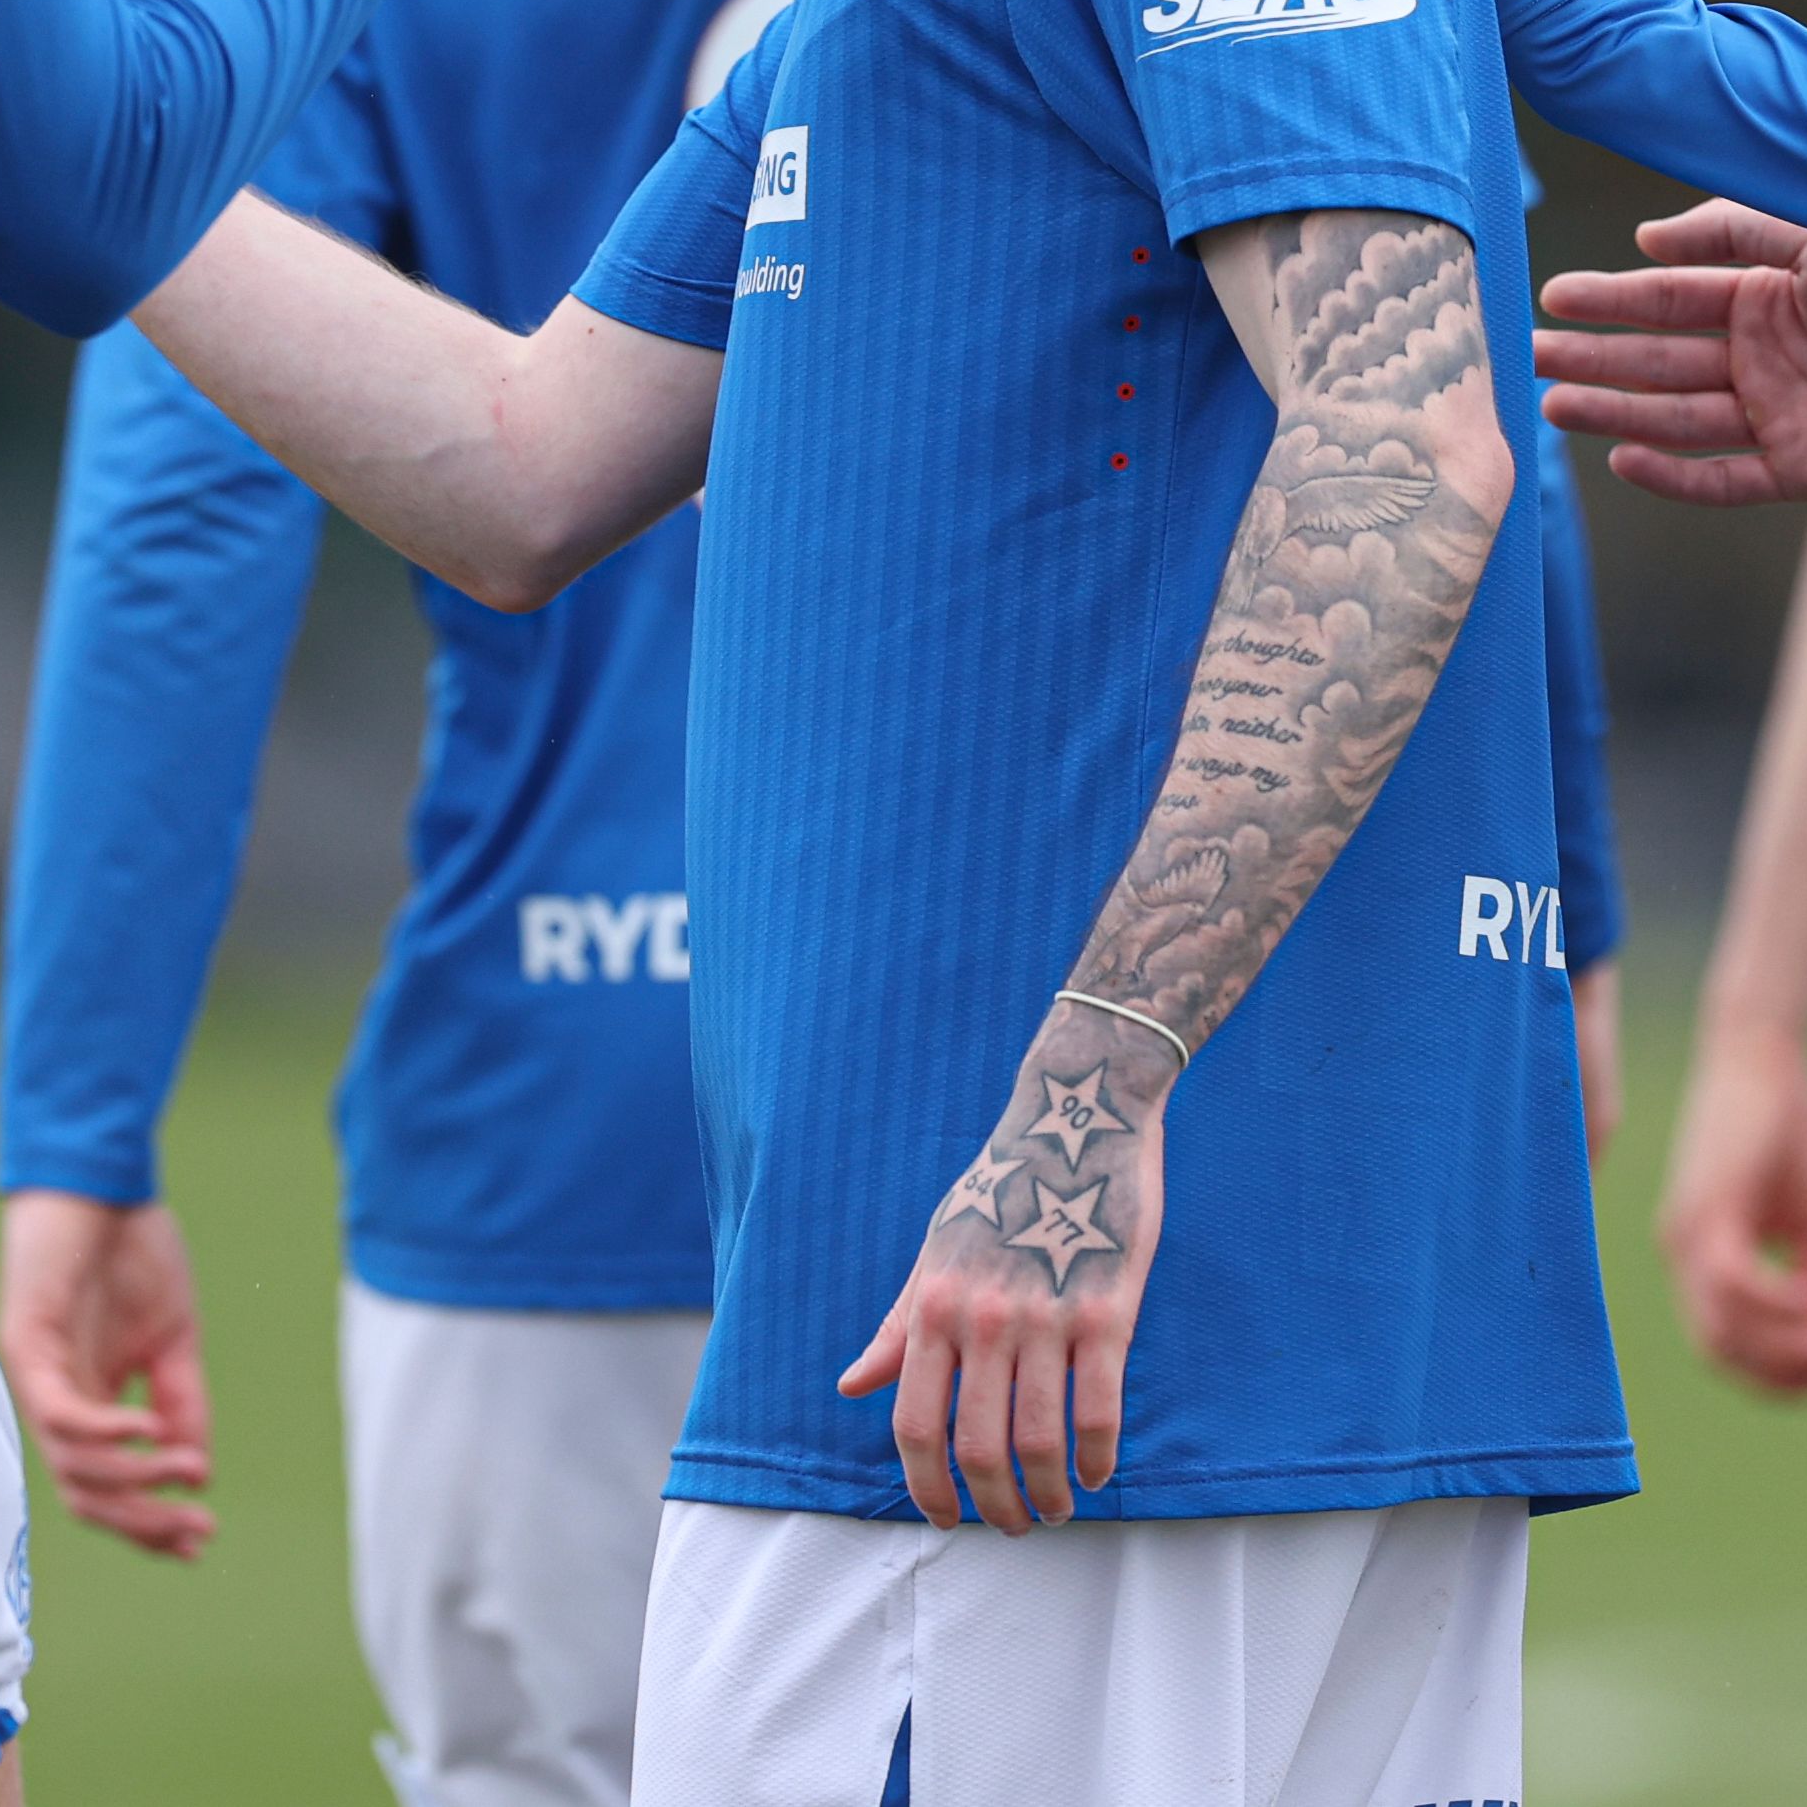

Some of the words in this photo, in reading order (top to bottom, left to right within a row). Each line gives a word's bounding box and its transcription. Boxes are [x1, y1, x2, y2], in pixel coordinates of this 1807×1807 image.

[1059, 1094, 1094, 1130] 90
[963, 1168, 994, 1197] 64
[1044, 1208, 1085, 1245] 77
